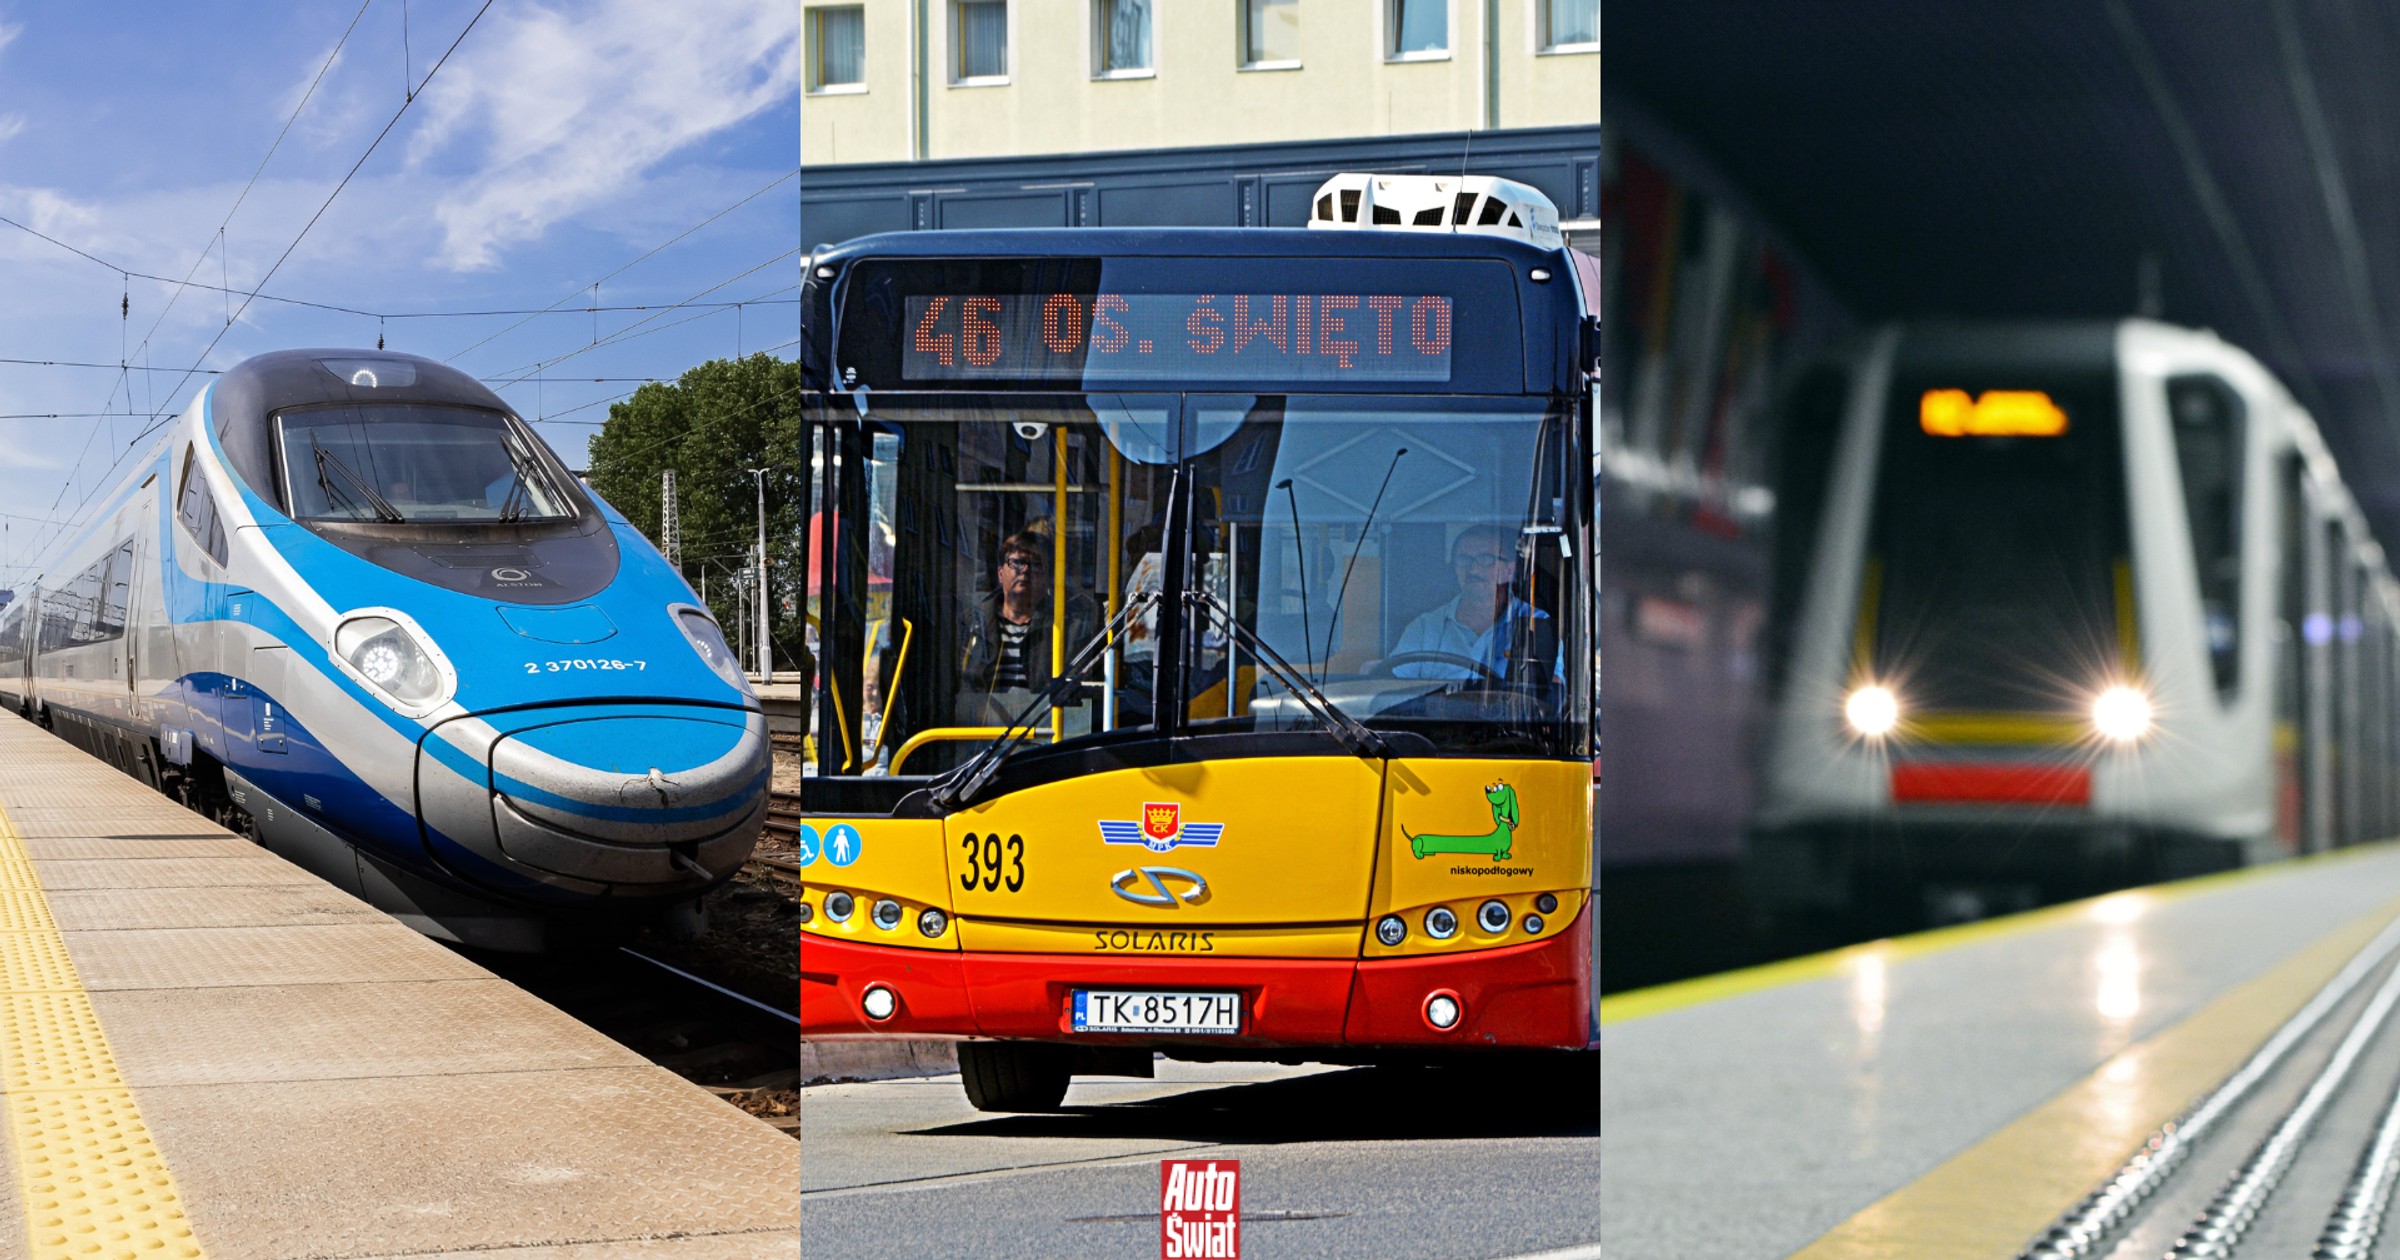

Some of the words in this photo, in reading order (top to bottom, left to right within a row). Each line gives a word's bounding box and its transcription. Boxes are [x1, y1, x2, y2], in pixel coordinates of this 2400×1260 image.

[915, 297, 1000, 365] 46
[1043, 293, 1153, 353] OS.
[524, 662, 541, 674] 2
[545, 659, 647, 673] 370126-7
[1152, 824, 1169, 833] CK
[1148, 841, 1173, 851] MPK
[960, 832, 1025, 893] 393
[1450, 865, 1534, 877] niskopodłogowy
[1094, 930, 1215, 951] SOLARIS
[1075, 1012, 1086, 1021] PL
[1094, 995, 1132, 1024] TK
[1144, 996, 1233, 1025] 8517H
